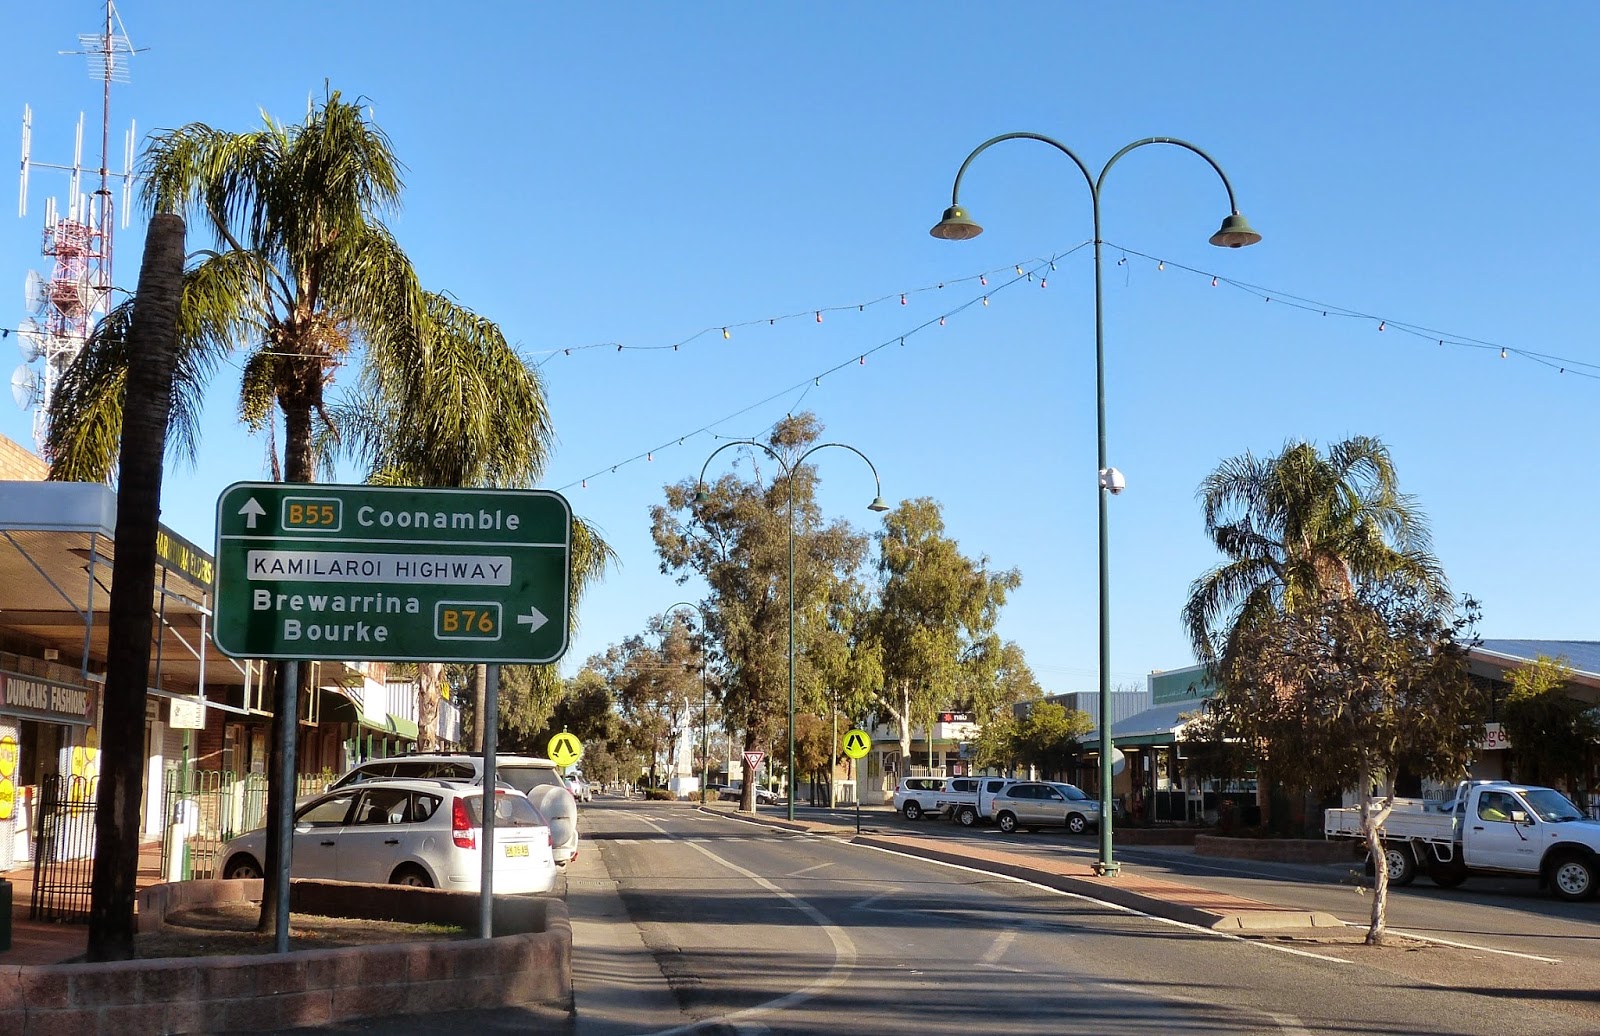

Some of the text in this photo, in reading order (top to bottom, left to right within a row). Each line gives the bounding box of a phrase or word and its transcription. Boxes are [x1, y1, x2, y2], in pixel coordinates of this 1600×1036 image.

[289, 504, 520, 531] B55 Coonamble
[190, 553, 212, 585] ELDERS
[254, 557, 504, 579] KAMILAROI HIGHWAY
[253, 589, 419, 614] Brewarrina
[284, 619, 388, 642] Bourke
[442, 609, 494, 632] B76
[6, 677, 87, 715] DUNCANS FASHIONS
[954, 713, 968, 721] nab
